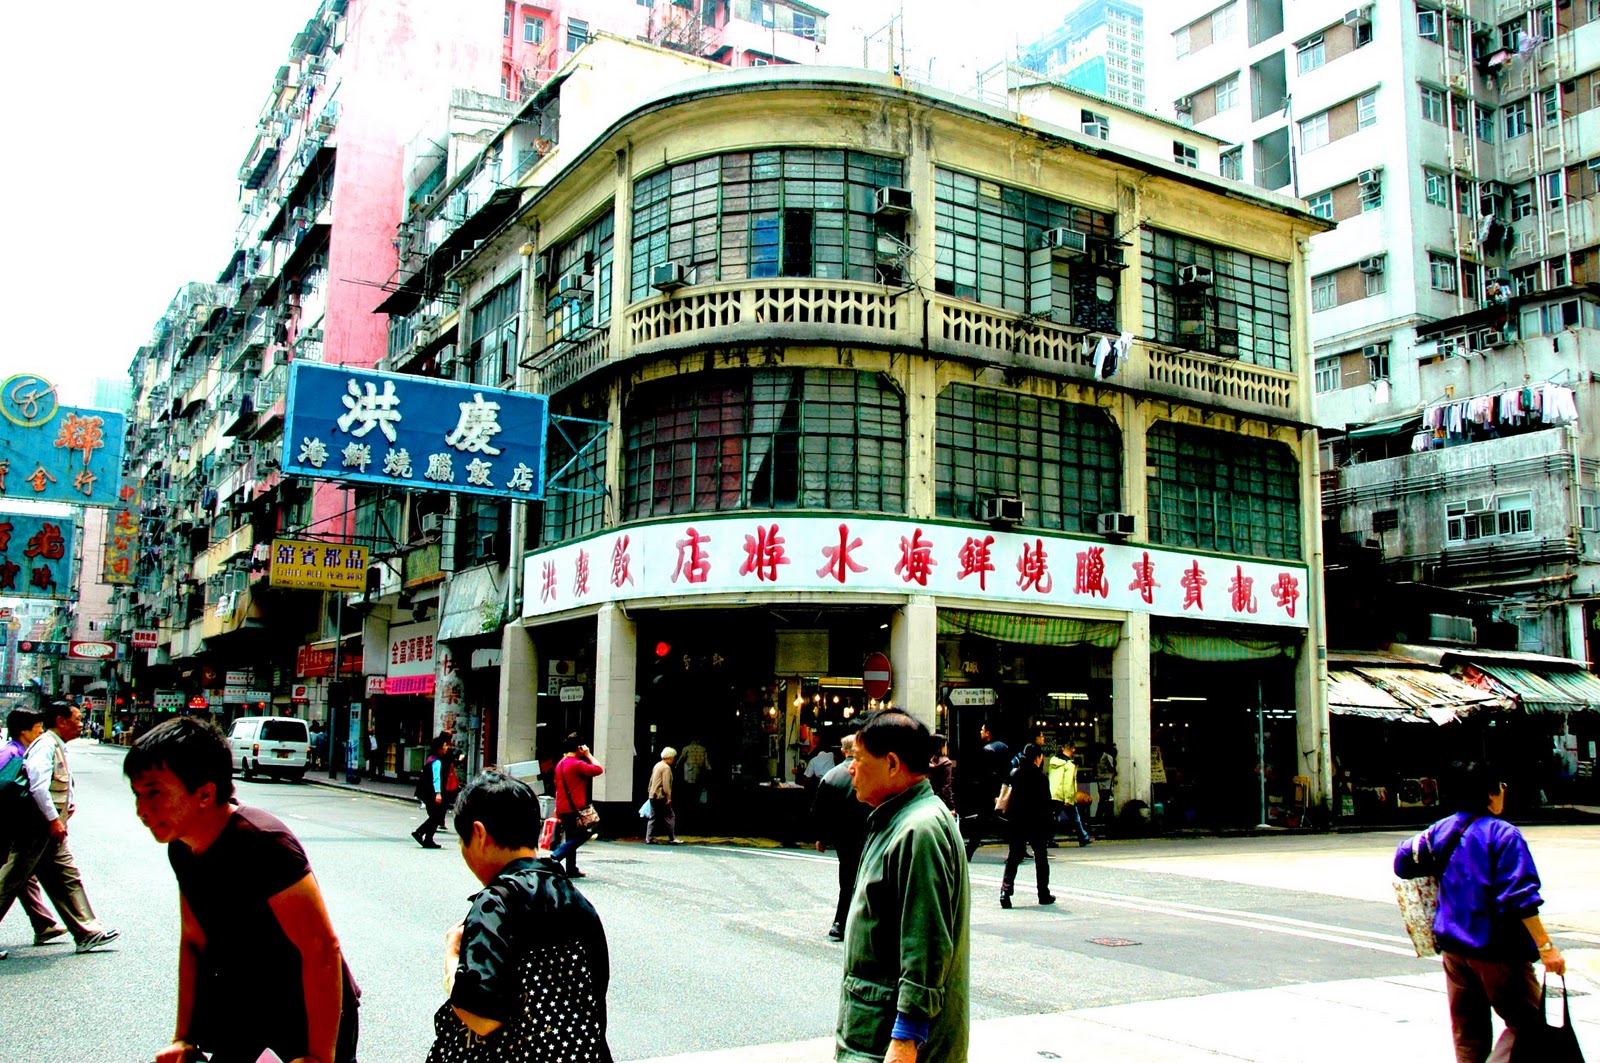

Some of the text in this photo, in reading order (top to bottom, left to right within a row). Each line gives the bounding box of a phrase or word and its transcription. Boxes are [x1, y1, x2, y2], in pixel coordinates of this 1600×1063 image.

[54, 412, 105, 465] 輝
[337, 378, 501, 455] 洪慶
[297, 437, 534, 492] 海鮮燒臘飯店
